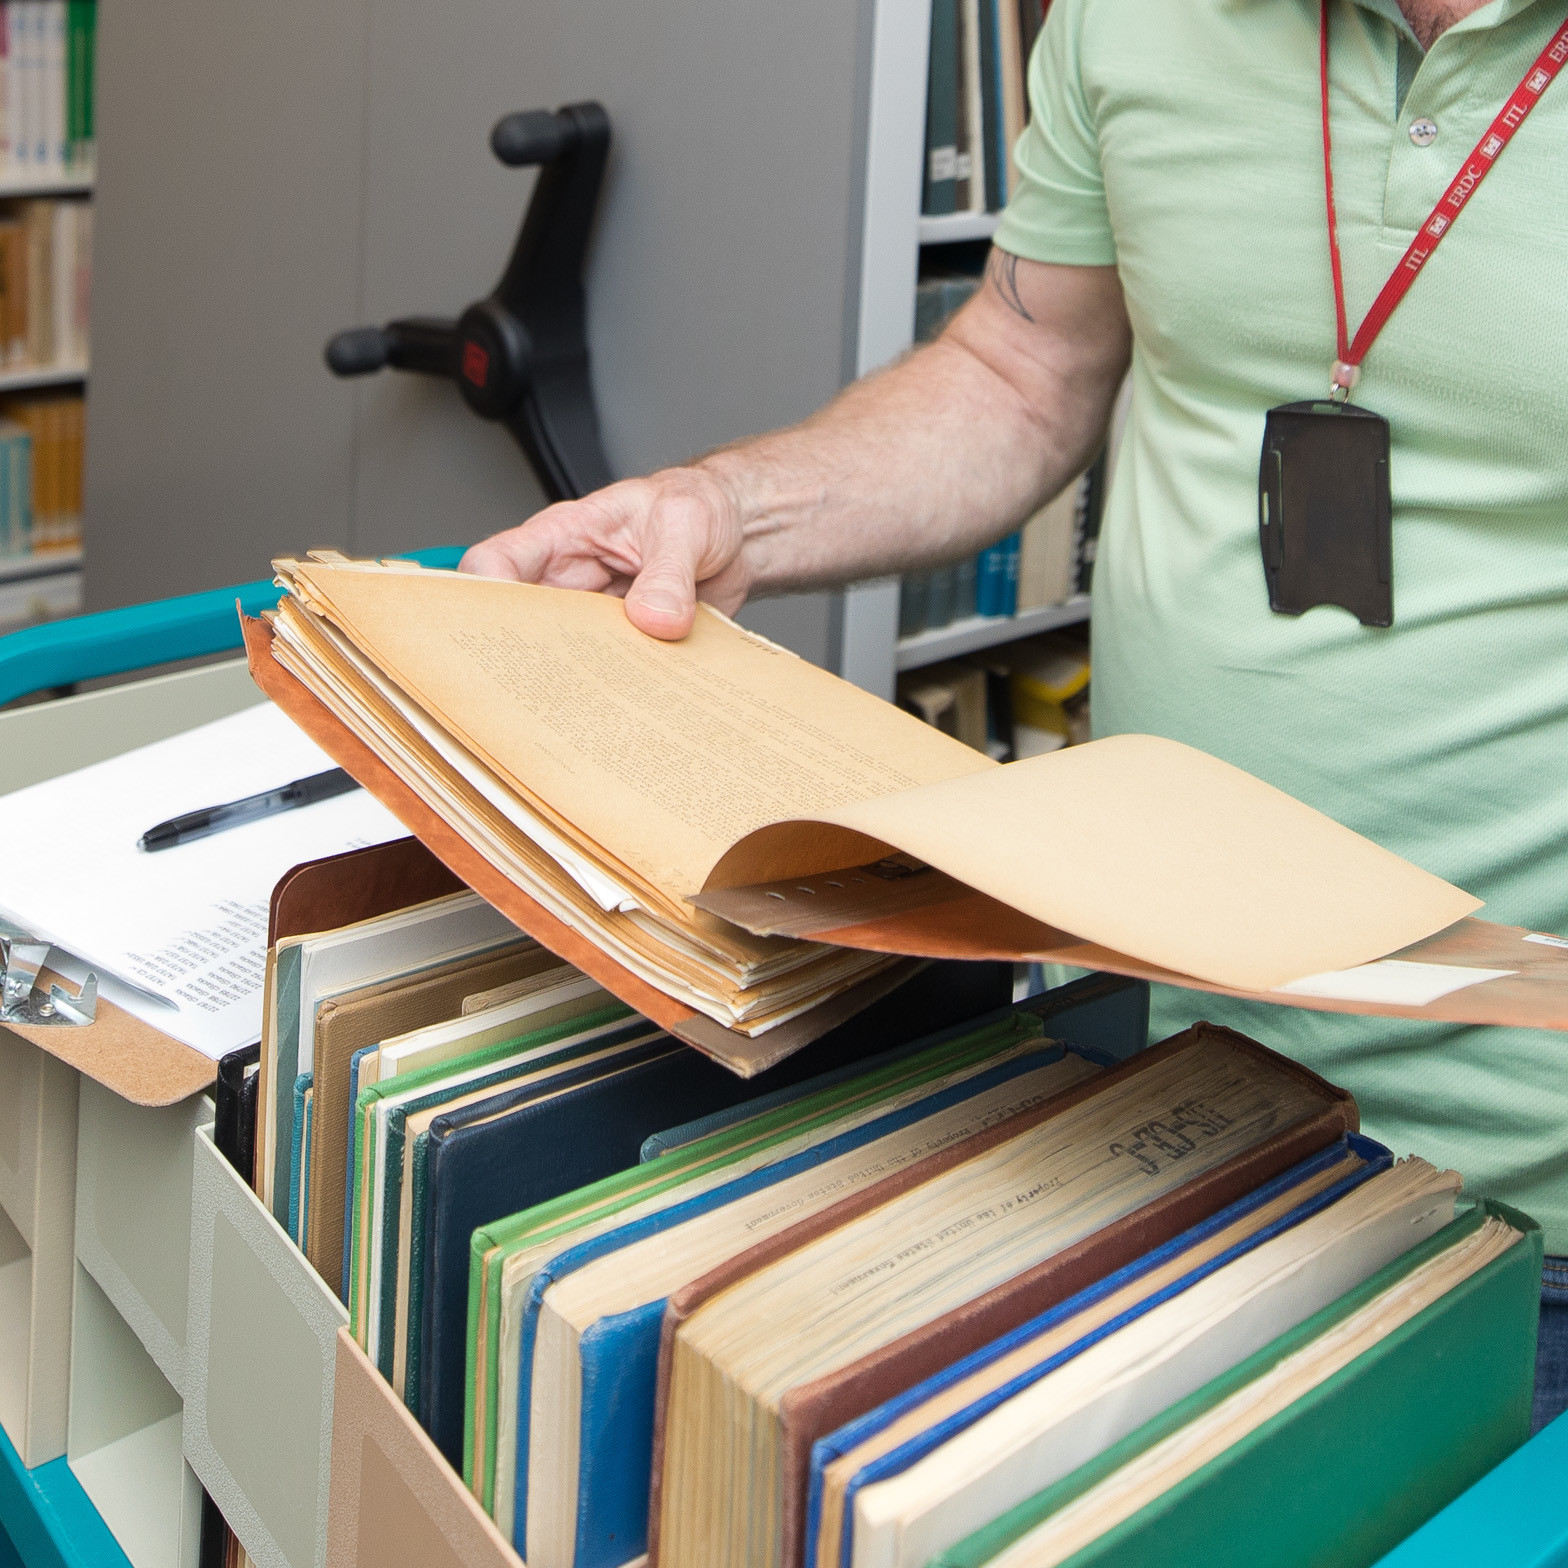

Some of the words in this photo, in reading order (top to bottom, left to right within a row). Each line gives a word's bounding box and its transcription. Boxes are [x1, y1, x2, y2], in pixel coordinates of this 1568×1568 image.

[1405, 247, 1429, 272] ITL
[1447, 164, 1482, 207] ERDC
[1502, 103, 1528, 129] ITL
[848, 1163, 886, 1184] United
[744, 1198, 805, 1231] Government
